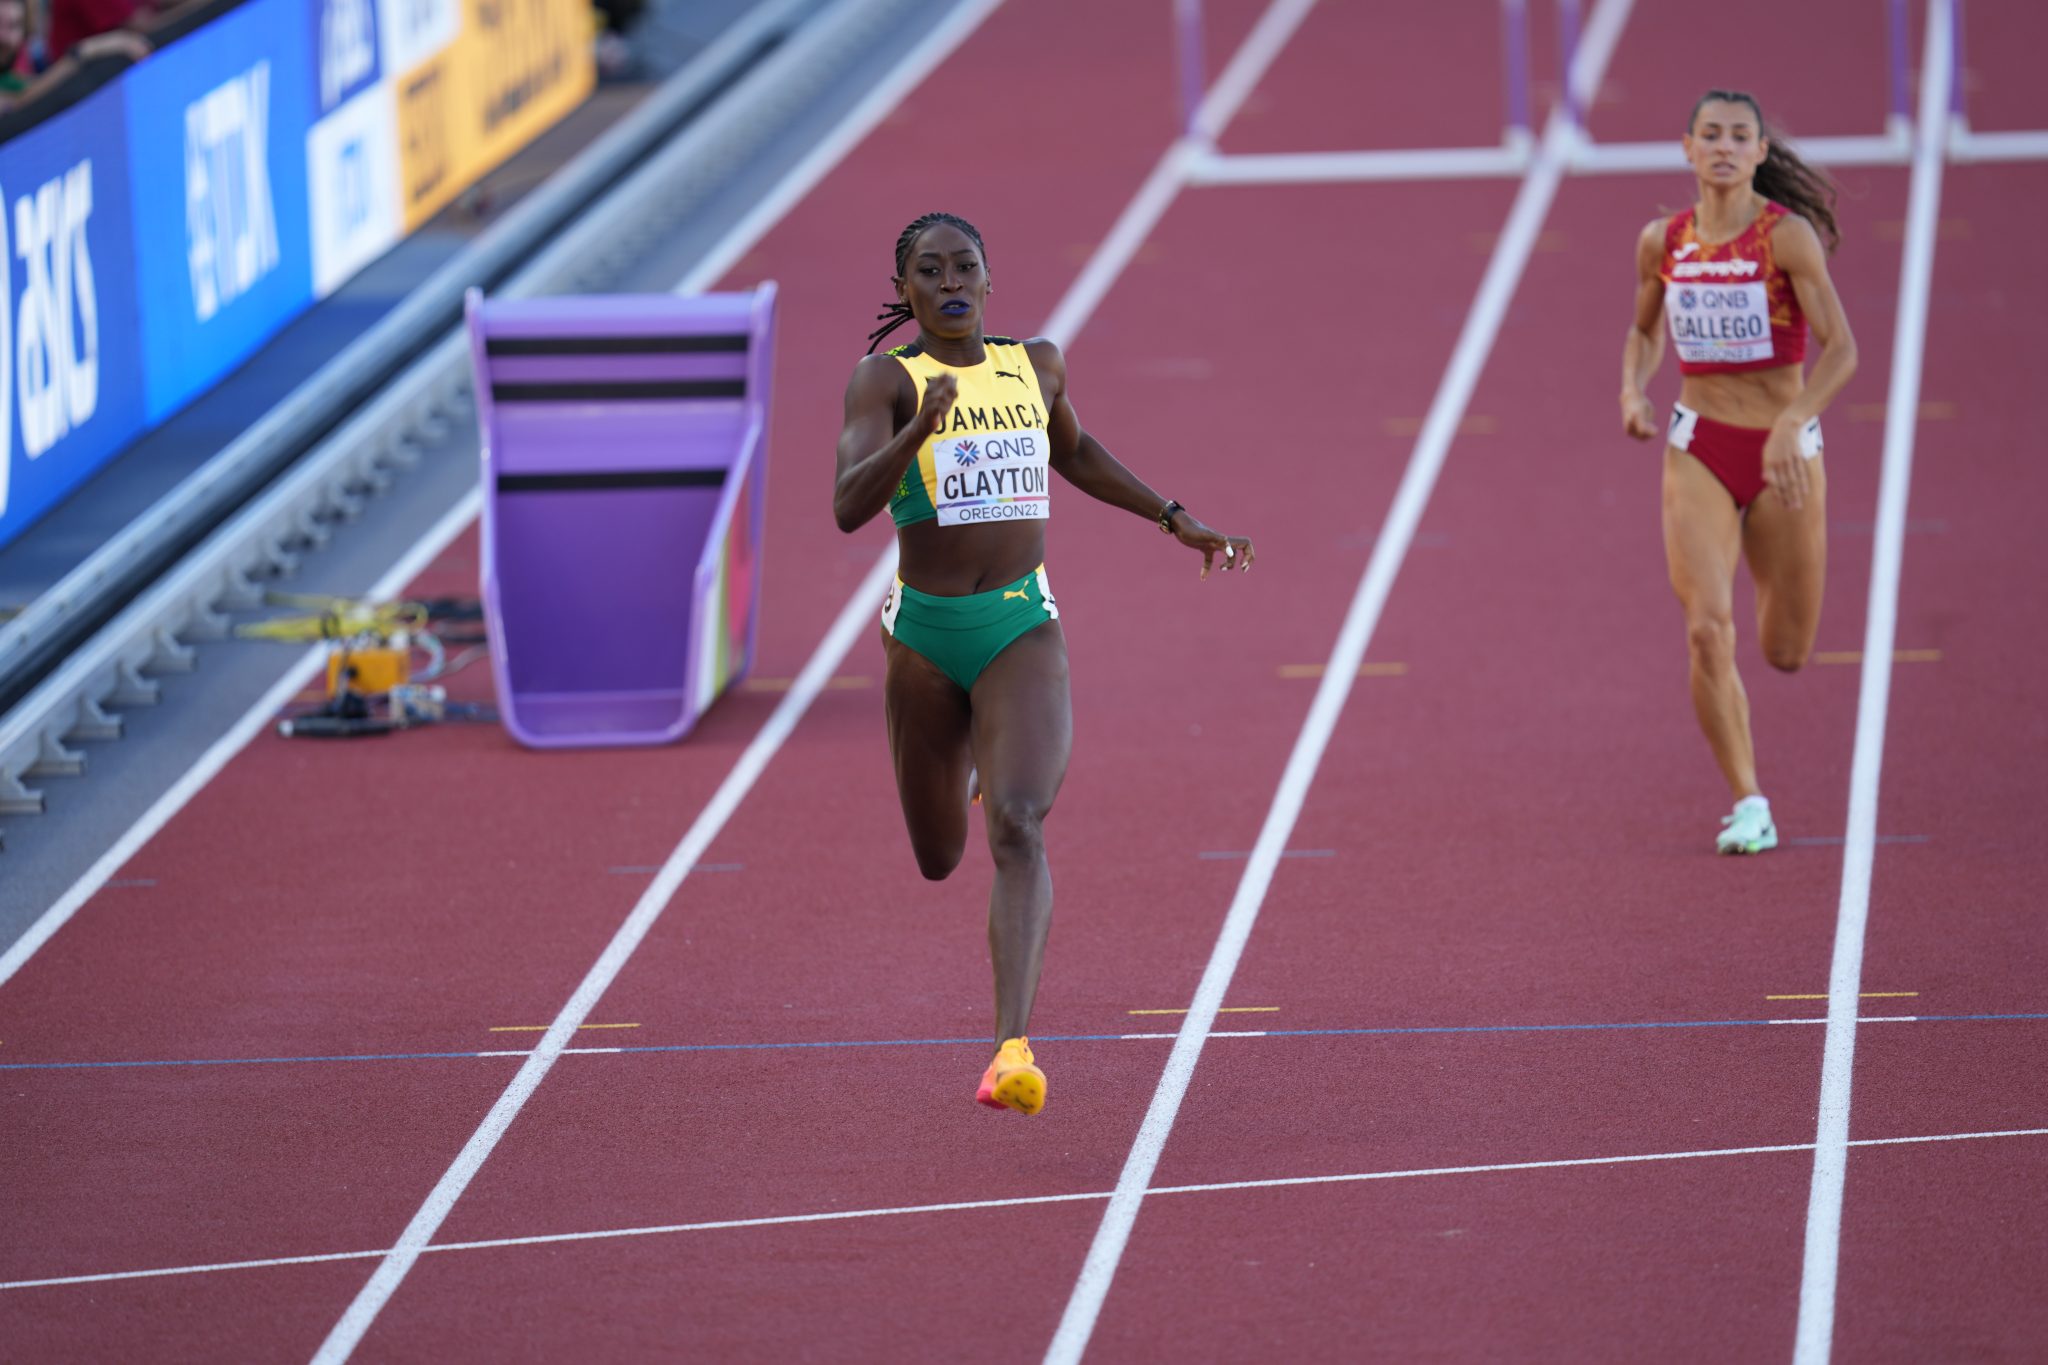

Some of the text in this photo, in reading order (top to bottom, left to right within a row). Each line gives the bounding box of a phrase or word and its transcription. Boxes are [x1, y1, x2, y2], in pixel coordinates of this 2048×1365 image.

[1702, 290, 1749, 309] QNB
[1673, 314, 1762, 339] GALLEGO
[934, 403, 1045, 434] JAMAICA
[985, 437, 1036, 460] QNB
[943, 466, 1044, 499] CLAYTON
[959, 503, 1038, 521] OREGON22
